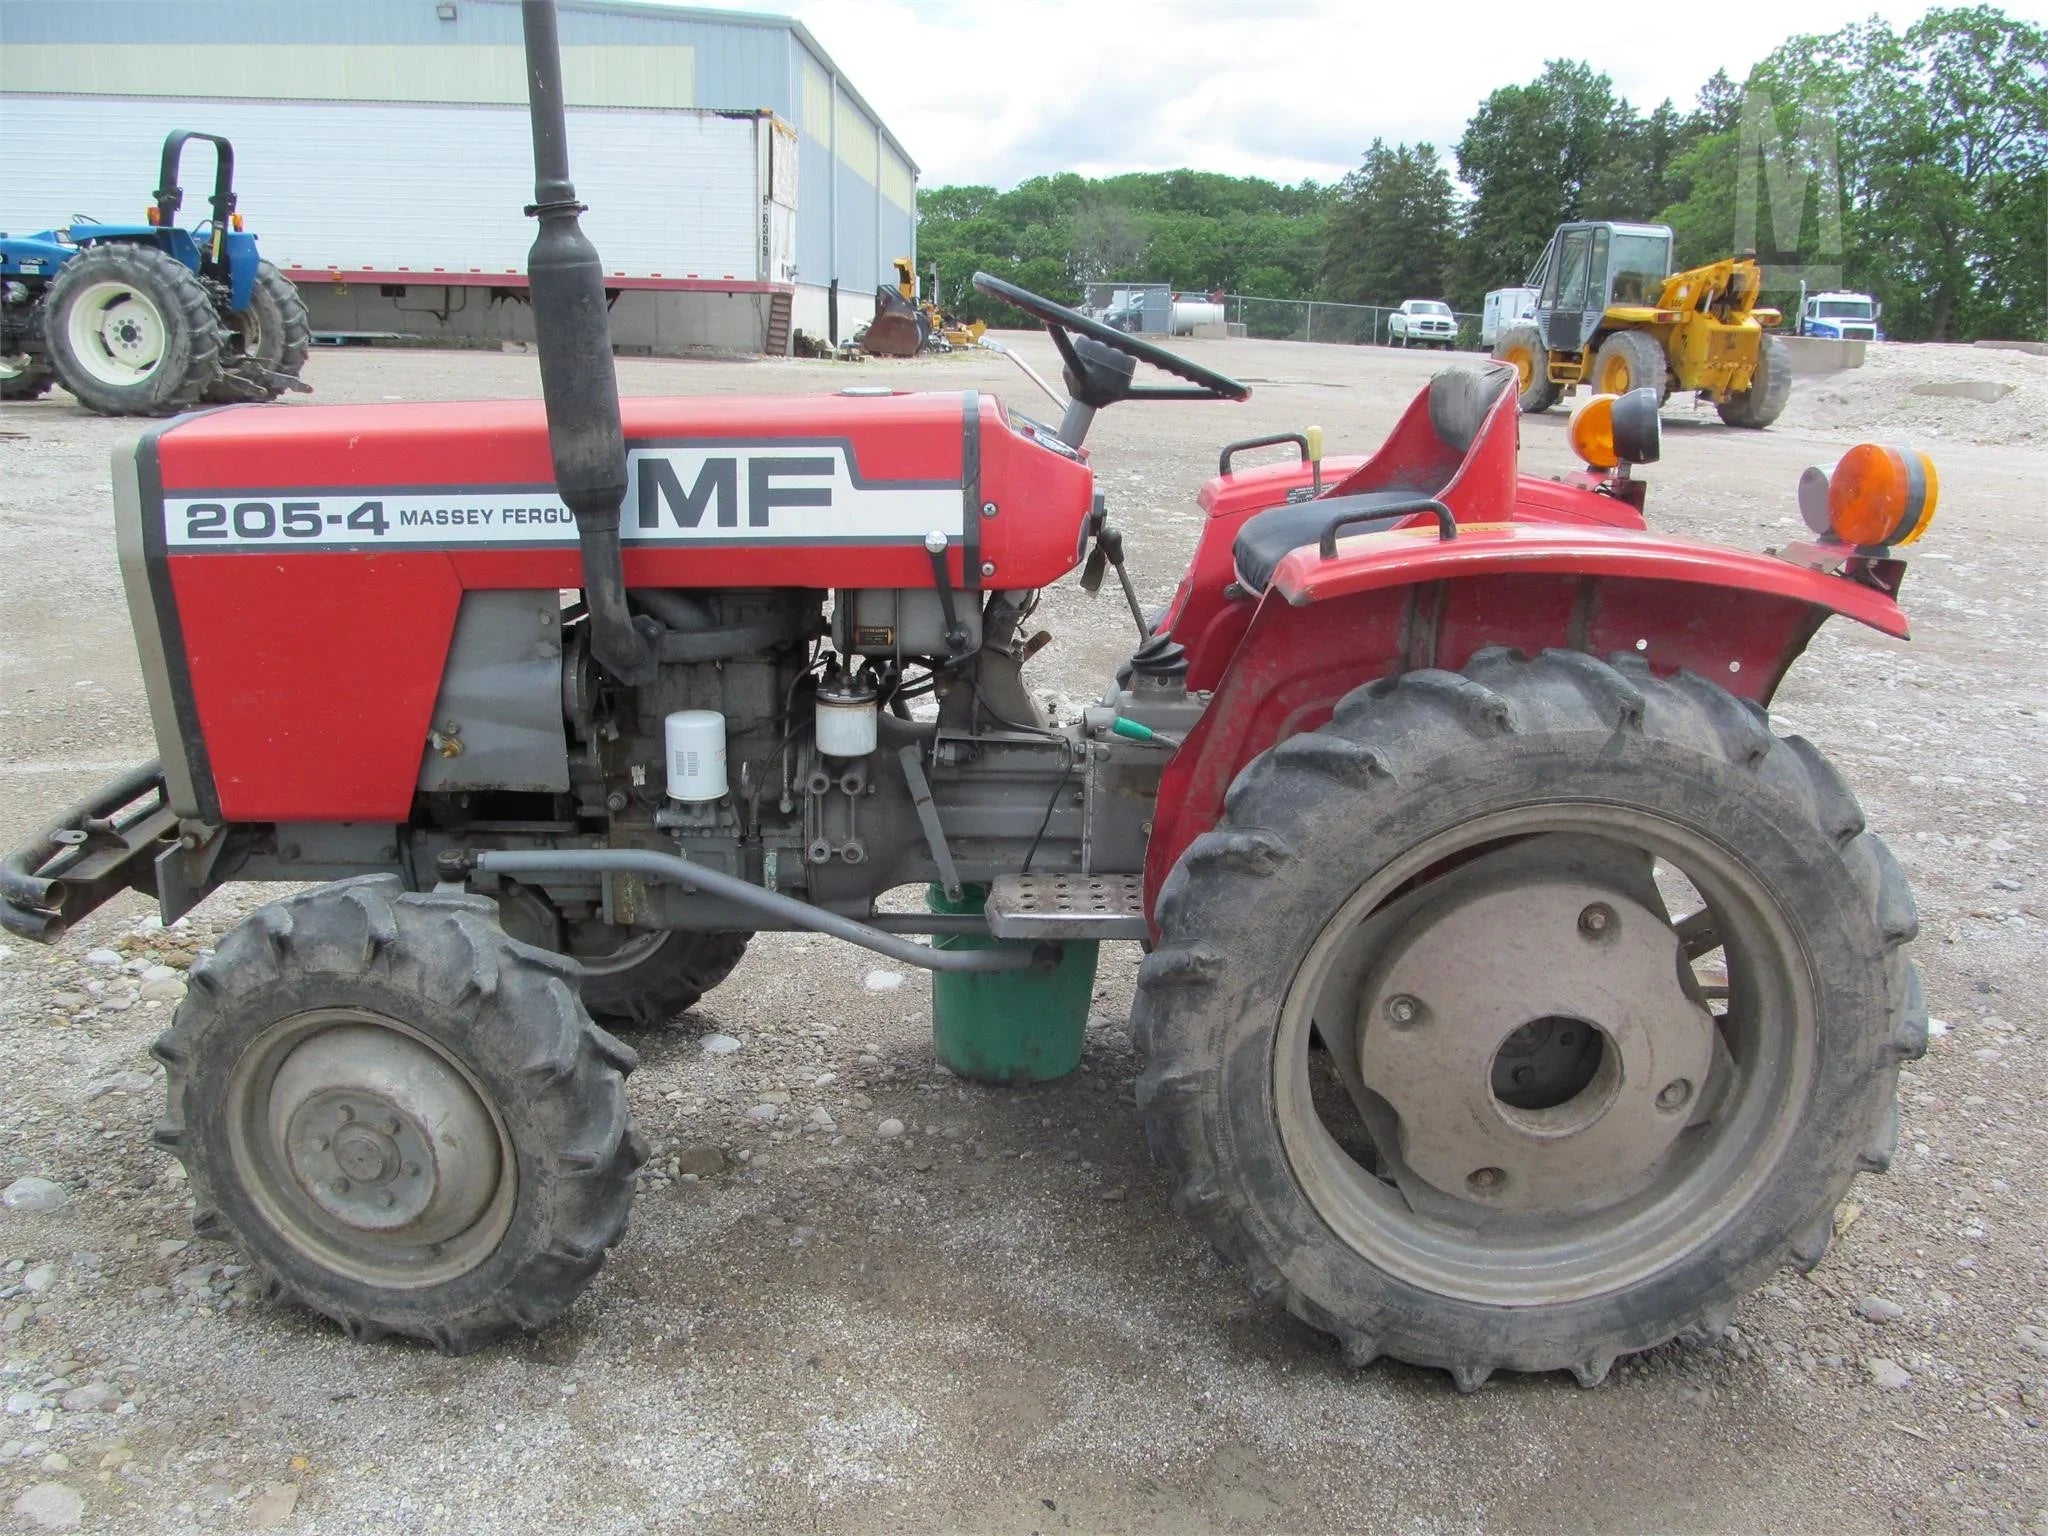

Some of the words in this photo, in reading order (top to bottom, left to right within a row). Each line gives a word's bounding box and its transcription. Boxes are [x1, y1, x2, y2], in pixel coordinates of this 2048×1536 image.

[637, 456, 836, 529] MF
[186, 502, 390, 539] 205-4
[400, 508, 494, 526] MASSEY
[502, 508, 573, 524] FERGU
